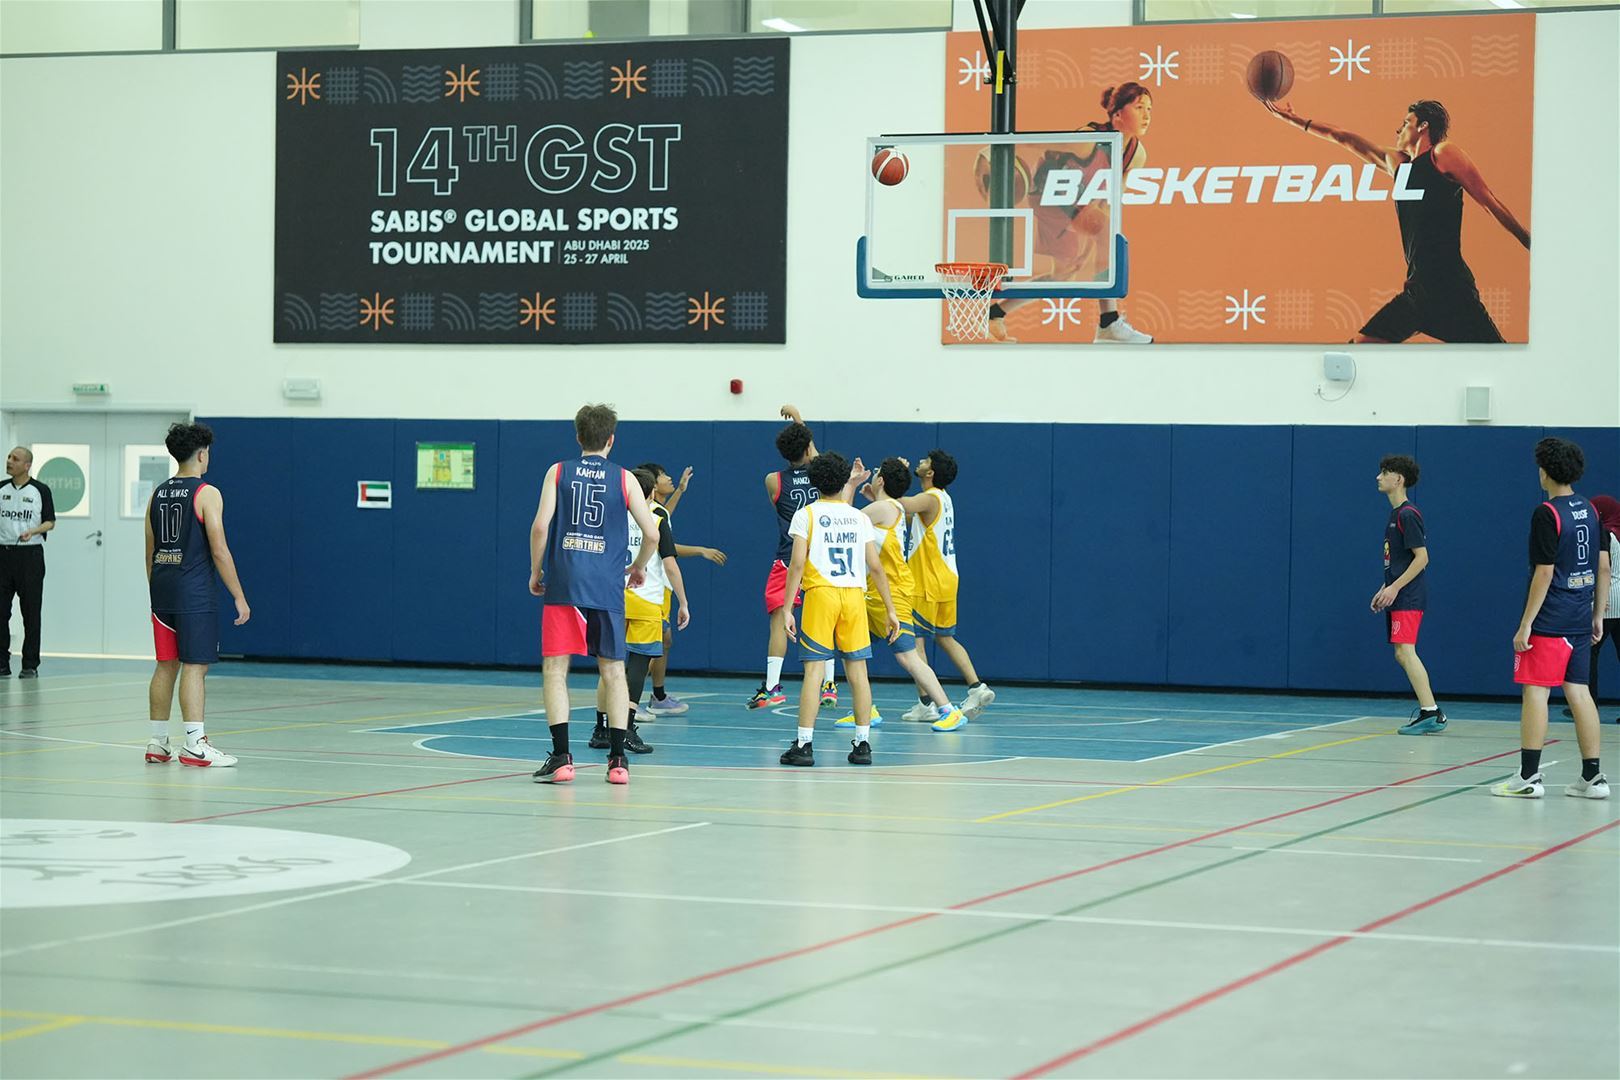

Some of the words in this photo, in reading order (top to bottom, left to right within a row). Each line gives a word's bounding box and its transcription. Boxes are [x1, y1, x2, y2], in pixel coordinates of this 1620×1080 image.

[370, 124, 517, 197] 14TH
[524, 123, 682, 195] GST
[1040, 163, 1425, 206] BASKETBALL
[465, 207, 569, 232] GLOBAL
[577, 206, 679, 231] SPORTS
[369, 241, 554, 265] TOURNAMENT
[564, 240, 586, 252] ABU
[588, 240, 621, 251] DHABI
[623, 240, 650, 251] 2025
[564, 254, 577, 265] 25
[585, 254, 600, 265] 27
[601, 253, 629, 264] APRIL
[576, 466, 606, 480] KAHTAN
[1, 510, 33, 520] capelli
[571, 481, 607, 528] 15
[159, 502, 183, 543] 10
[564, 538, 604, 552] SPARTANS
[823, 532, 834, 543] AL
[836, 532, 857, 543] AMRI
[1575, 524, 1590, 566] 8
[828, 547, 855, 577] 51
